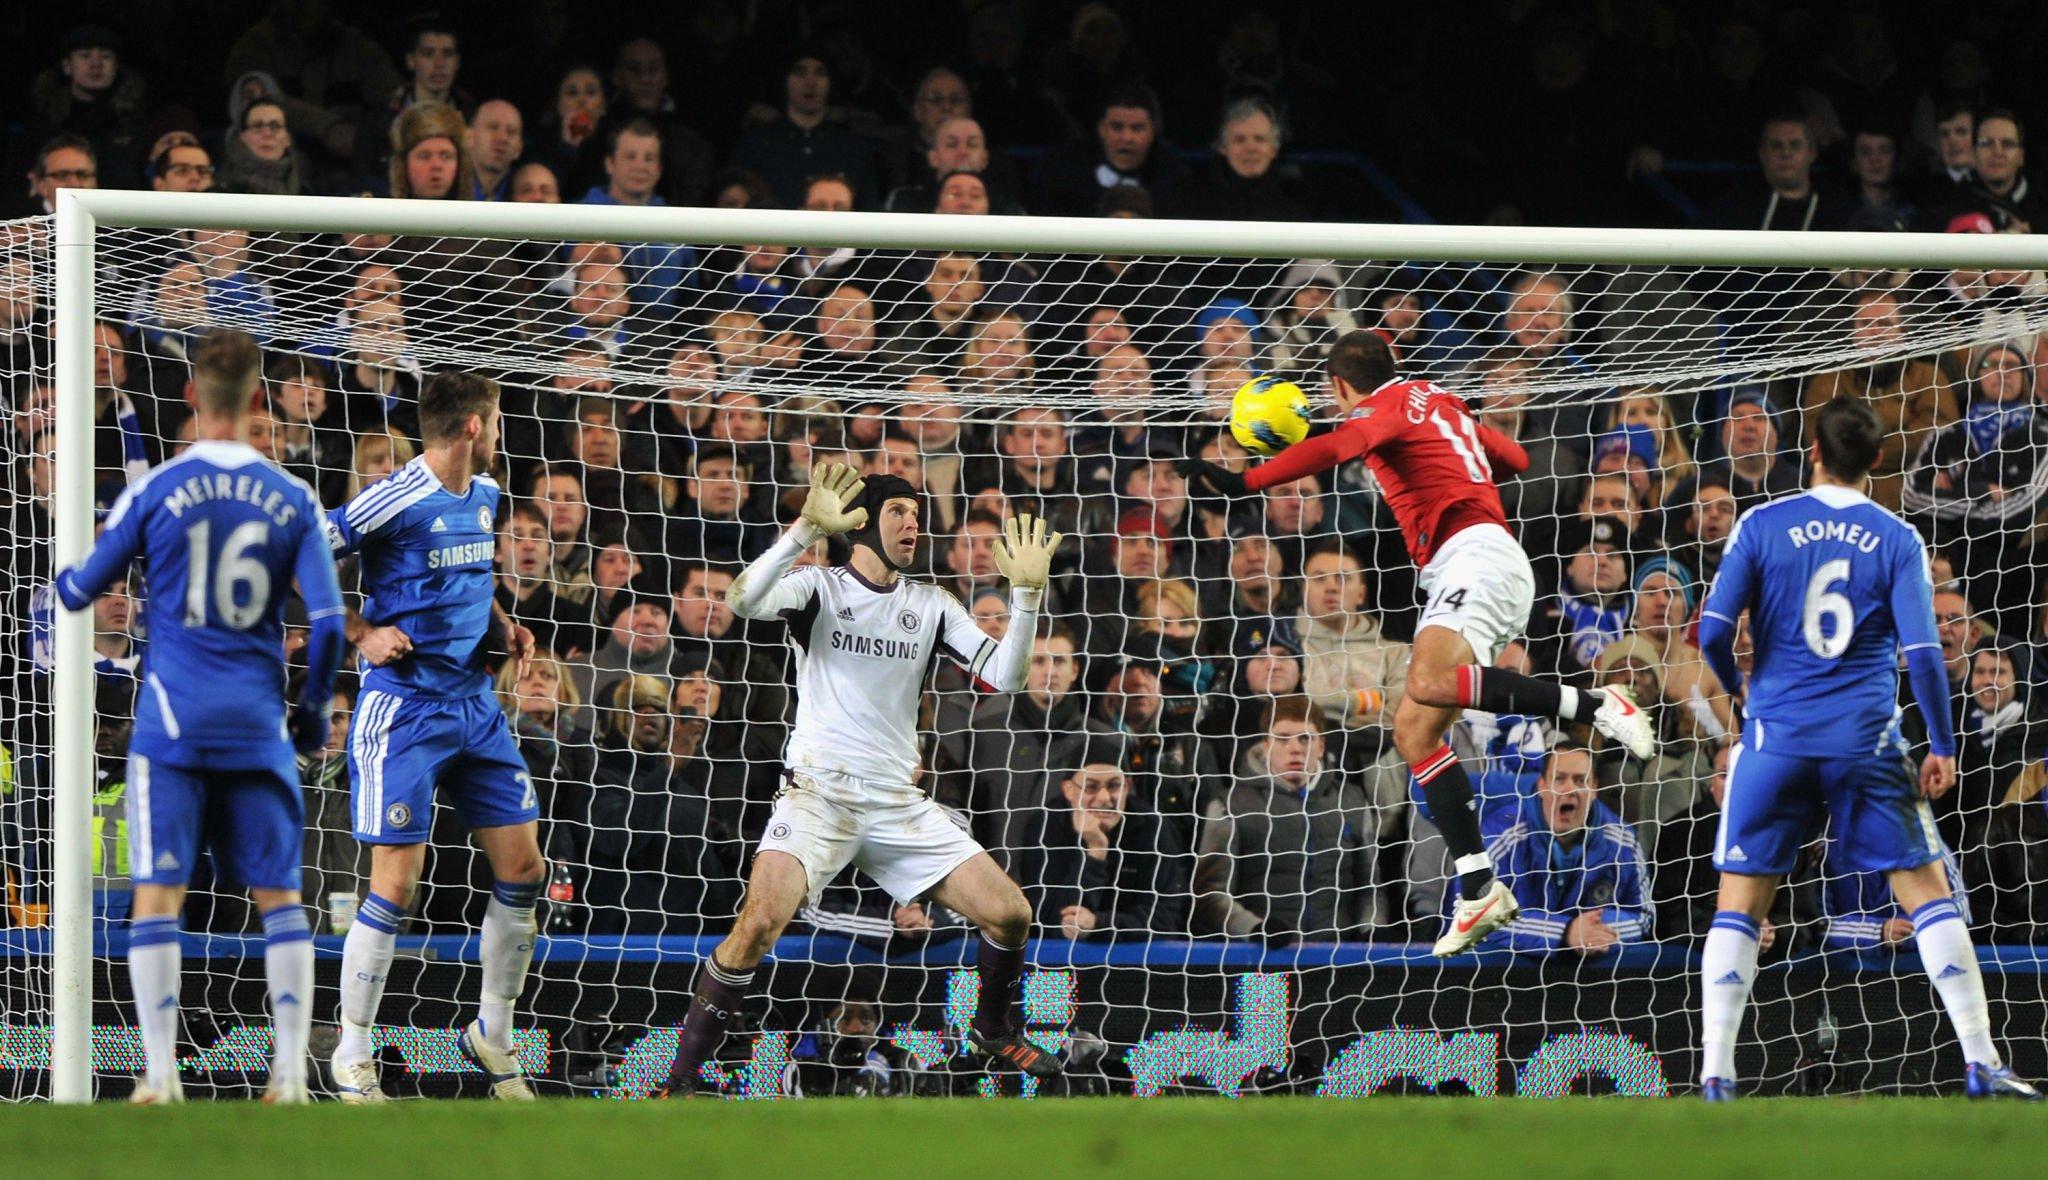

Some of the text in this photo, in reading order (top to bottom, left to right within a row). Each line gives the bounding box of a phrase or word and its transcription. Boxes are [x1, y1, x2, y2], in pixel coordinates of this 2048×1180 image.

[163, 473, 297, 527] MEIRELES
[1787, 519, 1881, 554] ROMEU
[183, 518, 271, 631] 16
[1431, 586, 1467, 610] 14
[1803, 558, 1855, 661] 6
[831, 630, 920, 660] SAMSUNG
[698, 994, 729, 1020] CFC
